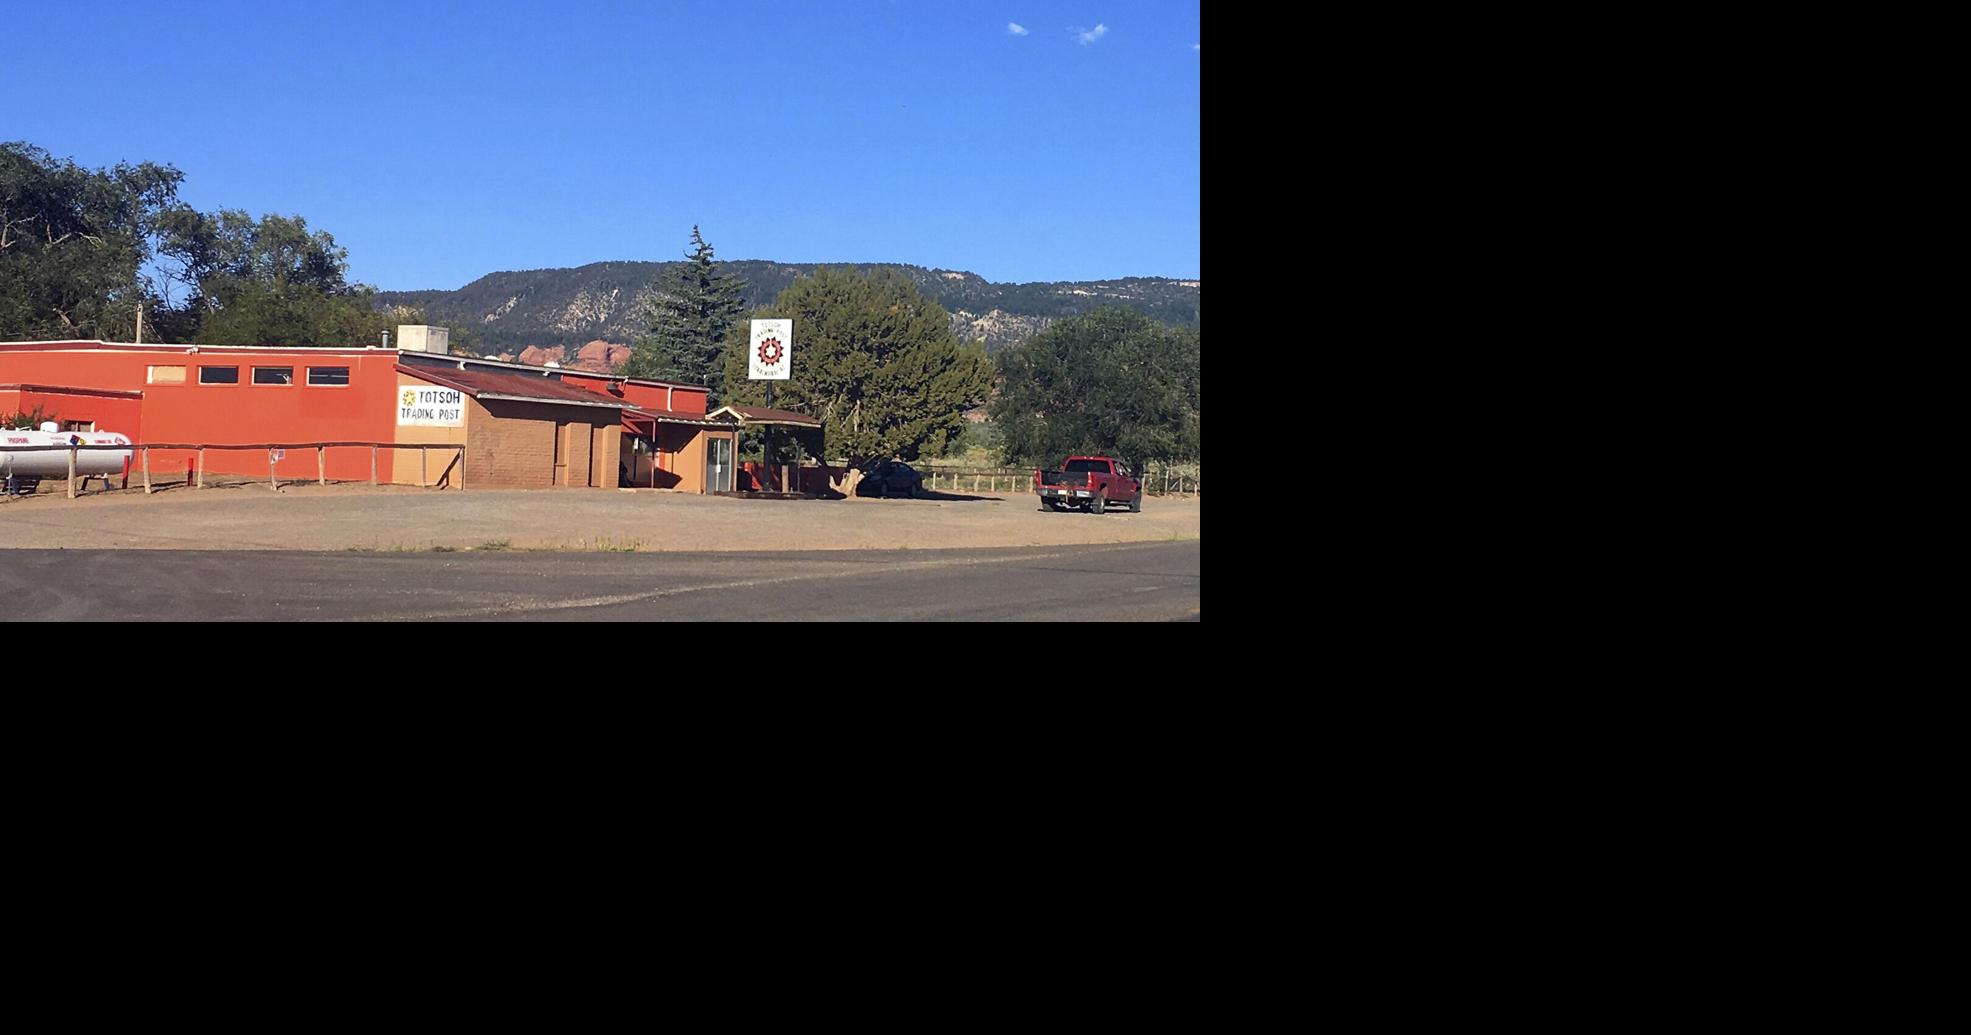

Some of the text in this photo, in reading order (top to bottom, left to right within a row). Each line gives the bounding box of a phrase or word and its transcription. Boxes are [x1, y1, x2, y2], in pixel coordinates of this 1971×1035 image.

[419, 391, 461, 404] TOTSOH
[401, 408, 460, 420] TRADING POST
